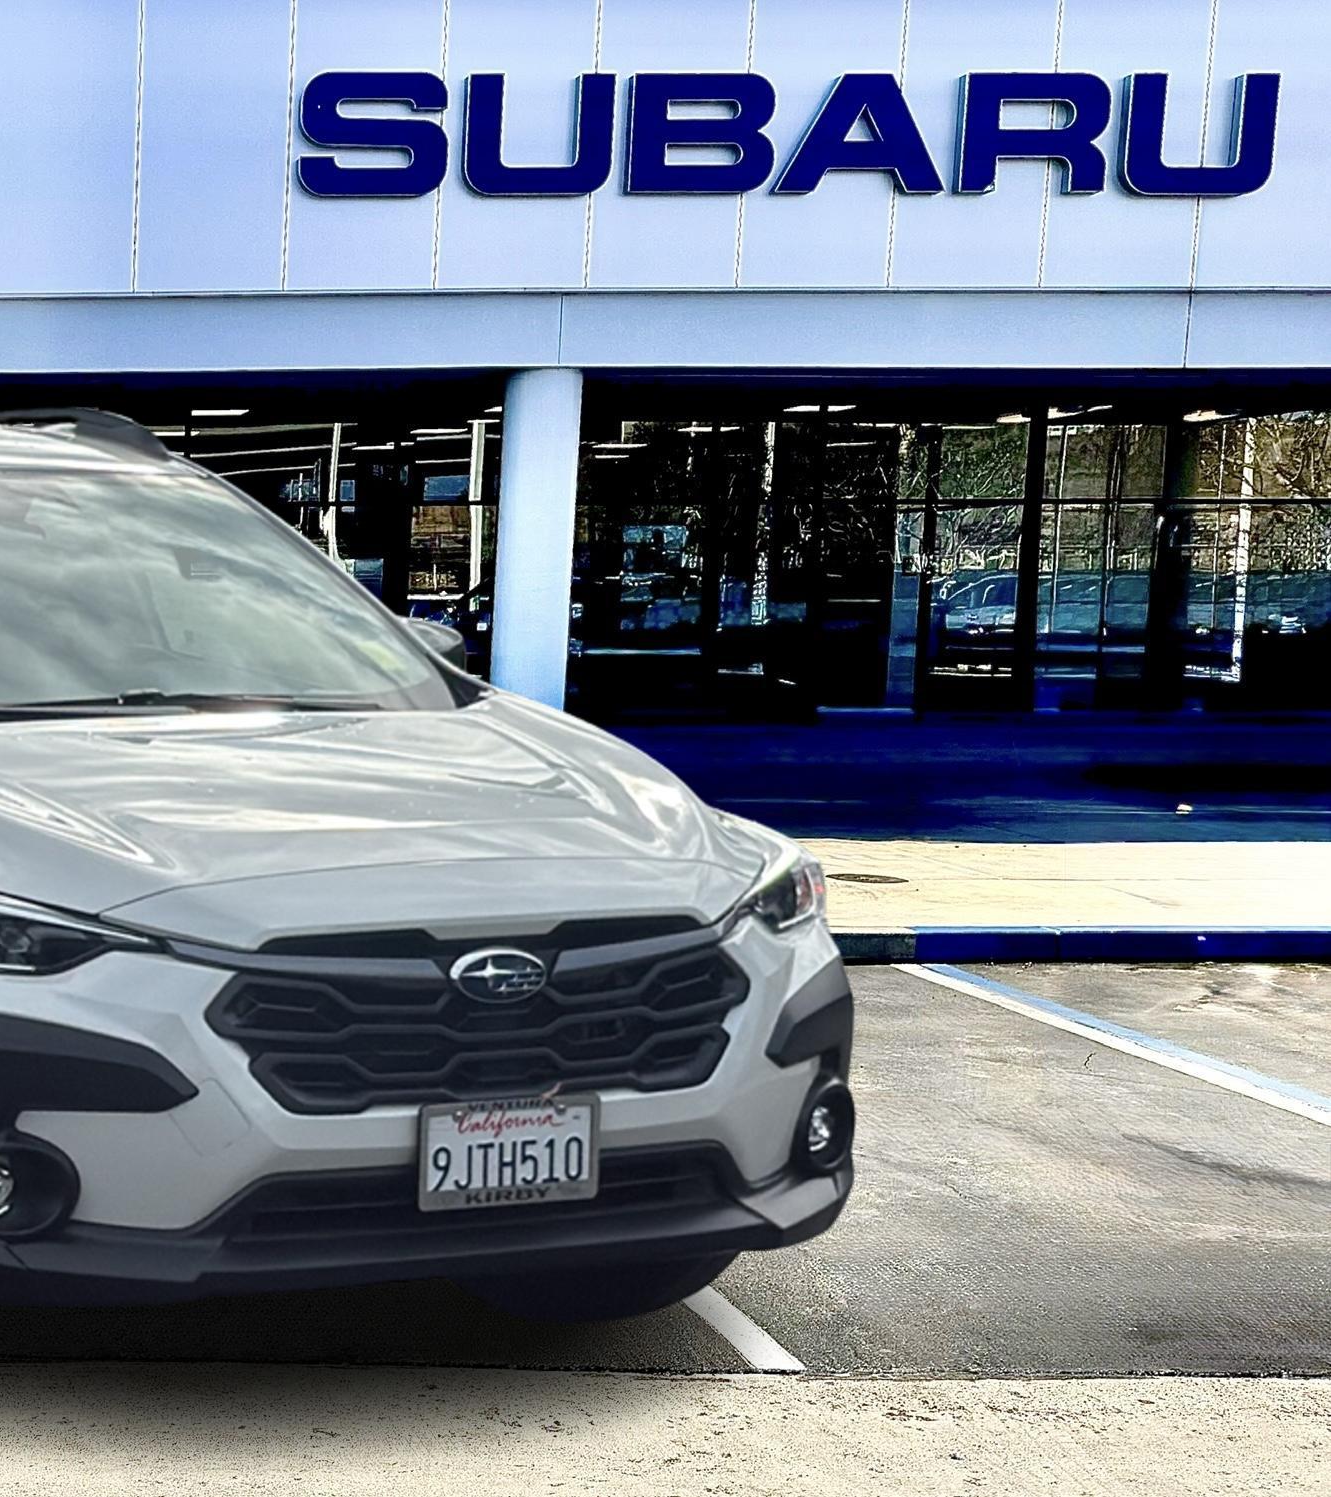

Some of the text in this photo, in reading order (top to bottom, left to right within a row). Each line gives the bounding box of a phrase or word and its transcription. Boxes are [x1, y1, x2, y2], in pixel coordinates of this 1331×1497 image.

[296, 71, 1281, 199] SUBARU
[457, 1109, 565, 1138] California
[431, 1136, 584, 1192] 9JTH510
[465, 1186, 551, 1205] KIRBY
